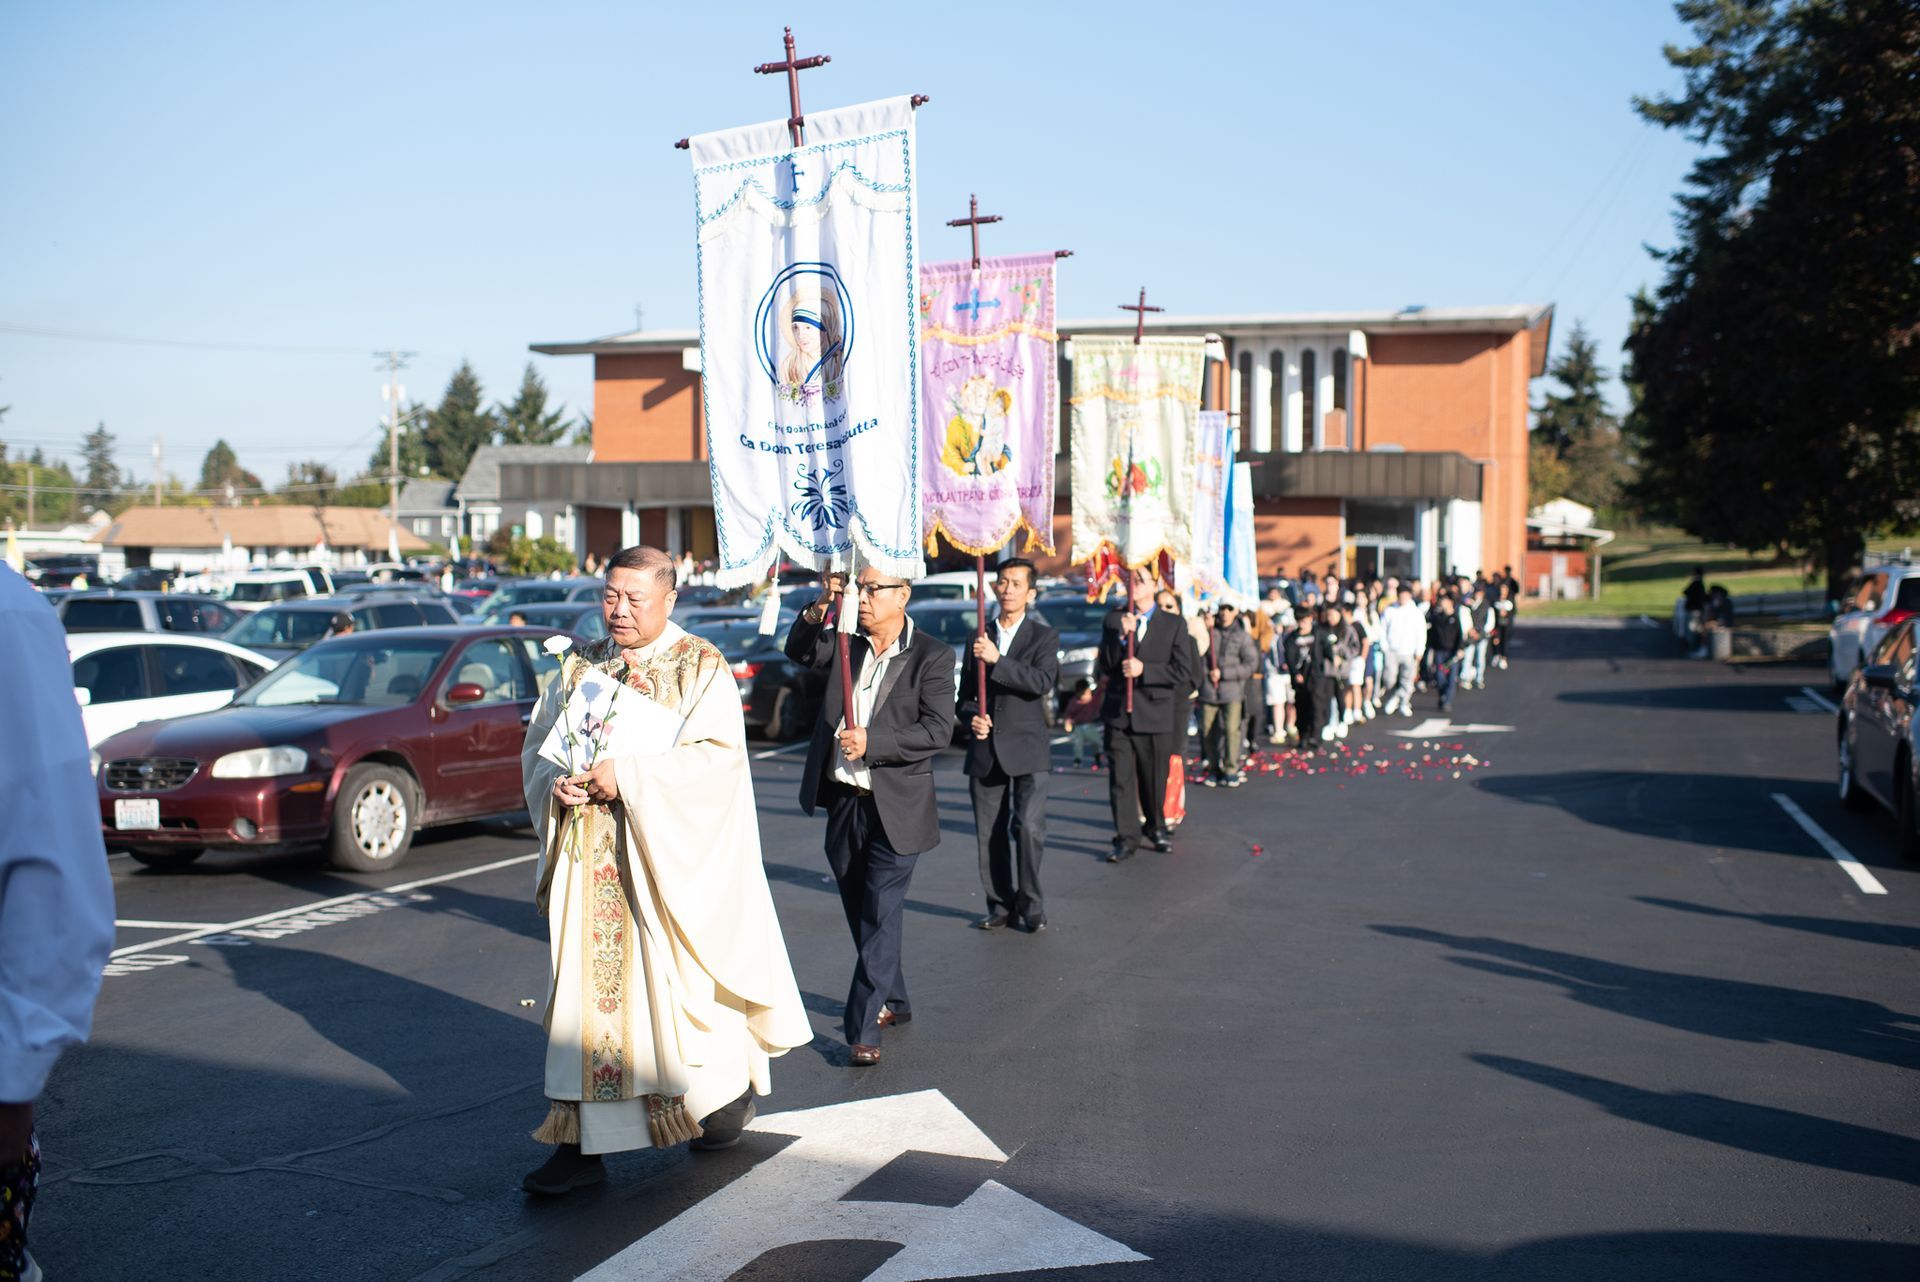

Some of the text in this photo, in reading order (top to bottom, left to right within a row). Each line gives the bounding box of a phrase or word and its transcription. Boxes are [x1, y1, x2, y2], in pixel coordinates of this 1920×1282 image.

[740, 433, 756, 450] Ca
[759, 440, 792, 455] Đoàn
[795, 439, 842, 455] Teresa
